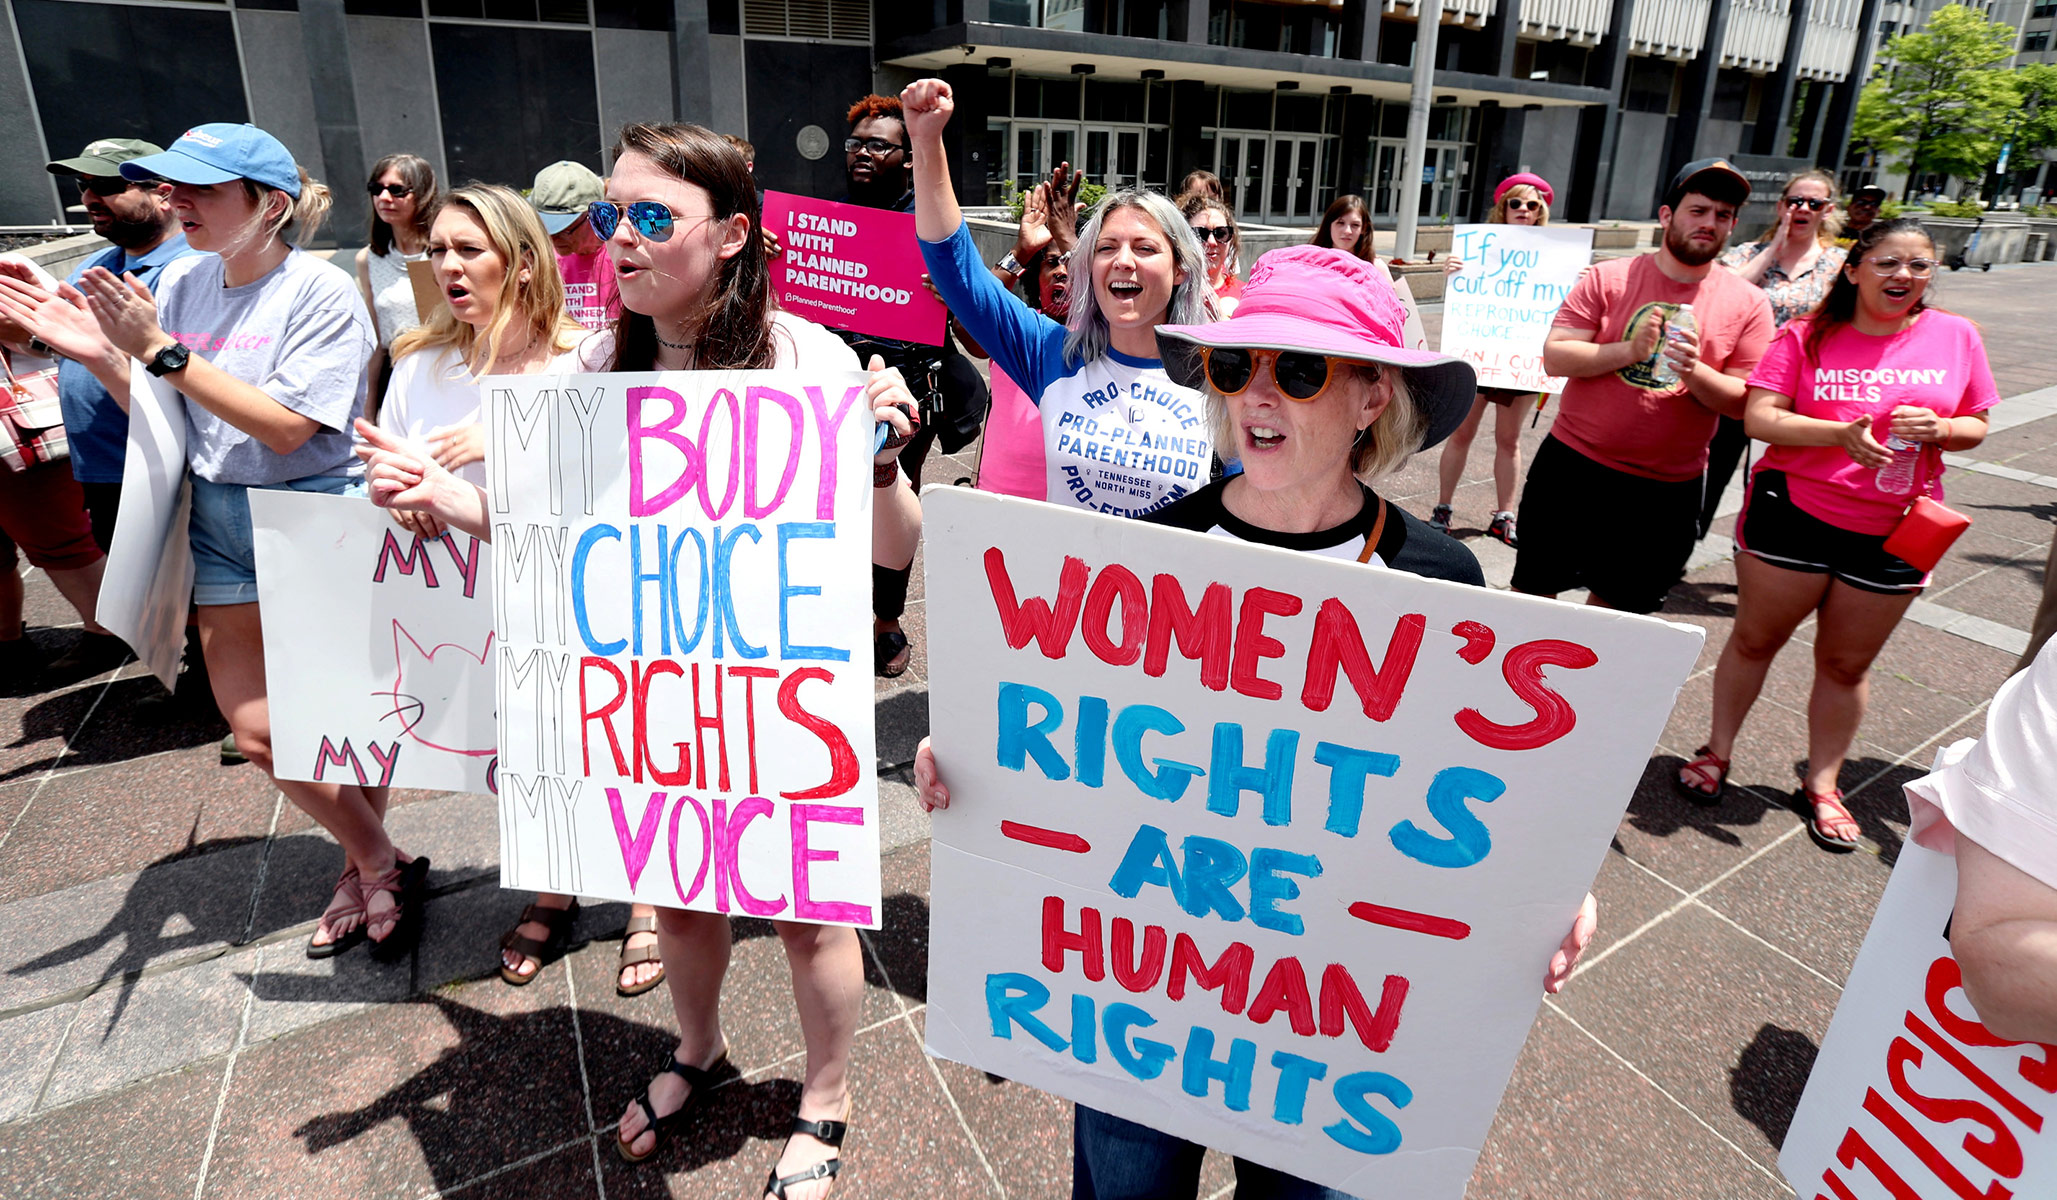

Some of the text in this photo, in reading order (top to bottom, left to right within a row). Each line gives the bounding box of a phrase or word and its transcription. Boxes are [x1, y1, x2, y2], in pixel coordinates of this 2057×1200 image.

[787, 211, 857, 237] I STAND
[787, 230, 834, 253] WITH
[786, 249, 868, 278] PLANNED
[1456, 230, 1539, 277] If you
[565, 285, 595, 295] TAND
[565, 297, 581, 307] ITH
[792, 294, 817, 307] Planned
[1451, 302, 1549, 325] REPRODUCT
[1453, 270, 1571, 313] cut off my
[1813, 385, 1881, 402] KILLS
[1815, 368, 1947, 385] MISOGYNY
[1082, 381, 1199, 430] PRO-CHOICE
[492, 386, 865, 520] MY BODY
[1058, 411, 1208, 459] PRO-PLANNED
[1058, 434, 1199, 480] PARENTHOOD
[1095, 480, 1152, 499] NORTH MISS
[1099, 470, 1152, 488] TENNESSEE
[373, 527, 480, 599] MY
[495, 522, 851, 662] MY CHOICE
[984, 547, 1599, 750] WOMEN'S
[500, 646, 860, 800] MY RIGHTS
[313, 734, 401, 787] MY
[997, 682, 1507, 869] RIGHTS
[501, 773, 873, 925] MY VOICE
[1109, 824, 1324, 935] ARE
[1041, 896, 1410, 1053] HUMAN
[985, 972, 1413, 1155] RIGHTS
